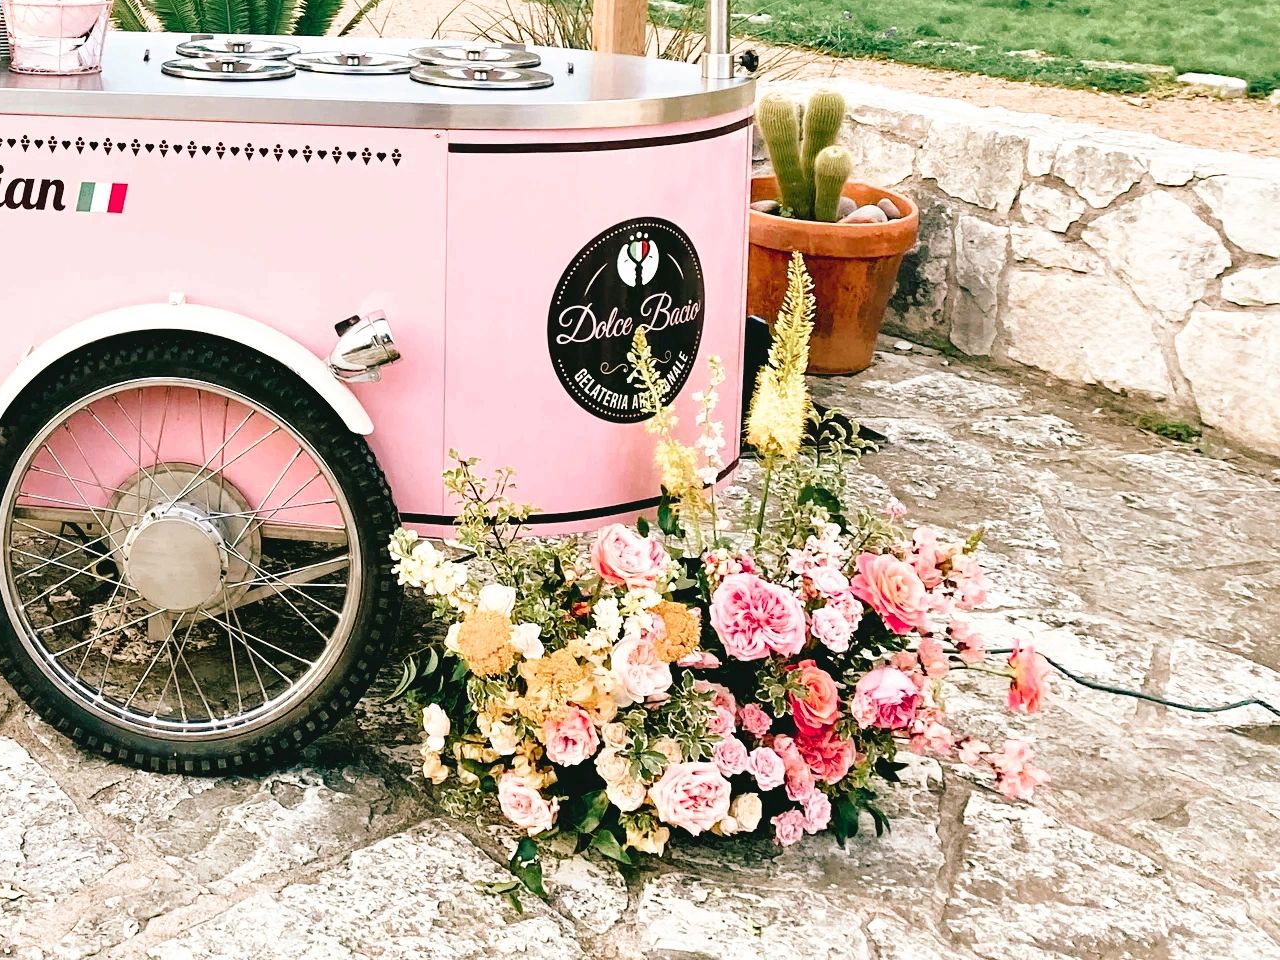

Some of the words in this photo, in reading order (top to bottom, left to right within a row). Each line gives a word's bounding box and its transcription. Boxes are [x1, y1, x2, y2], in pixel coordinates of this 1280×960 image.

[556, 303, 632, 345] Dolce
[639, 291, 701, 333] Bacio
[574, 367, 629, 410] GELATERIA
